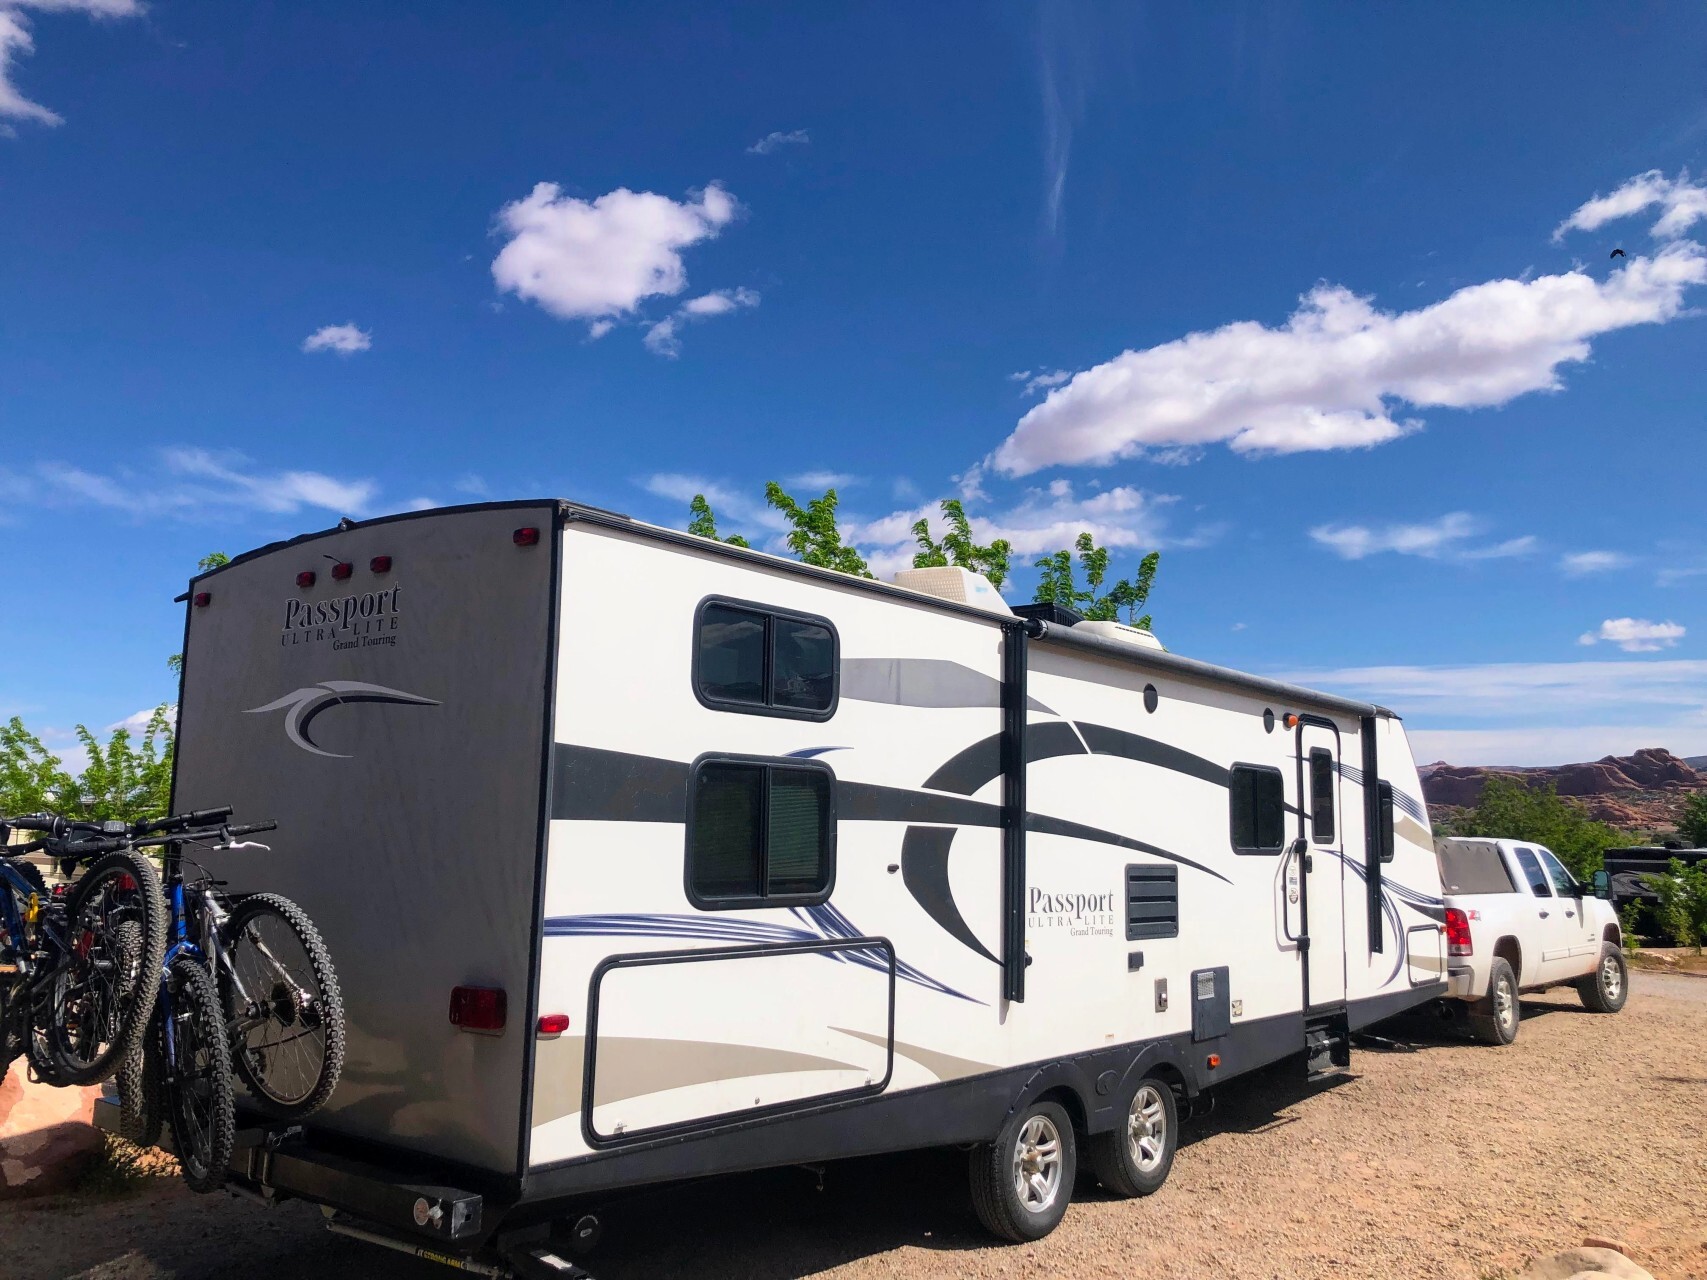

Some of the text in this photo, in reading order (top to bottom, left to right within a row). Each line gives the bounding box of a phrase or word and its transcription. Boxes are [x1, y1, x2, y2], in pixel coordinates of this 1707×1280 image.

[282, 581, 401, 632] Passport
[281, 616, 398, 647] ULTRA LITE
[332, 633, 397, 651] Grand Touring
[1028, 887, 1114, 920] Passport
[1028, 914, 1114, 928] ULTRA LITE
[1070, 926, 1114, 937] Grand Touring
